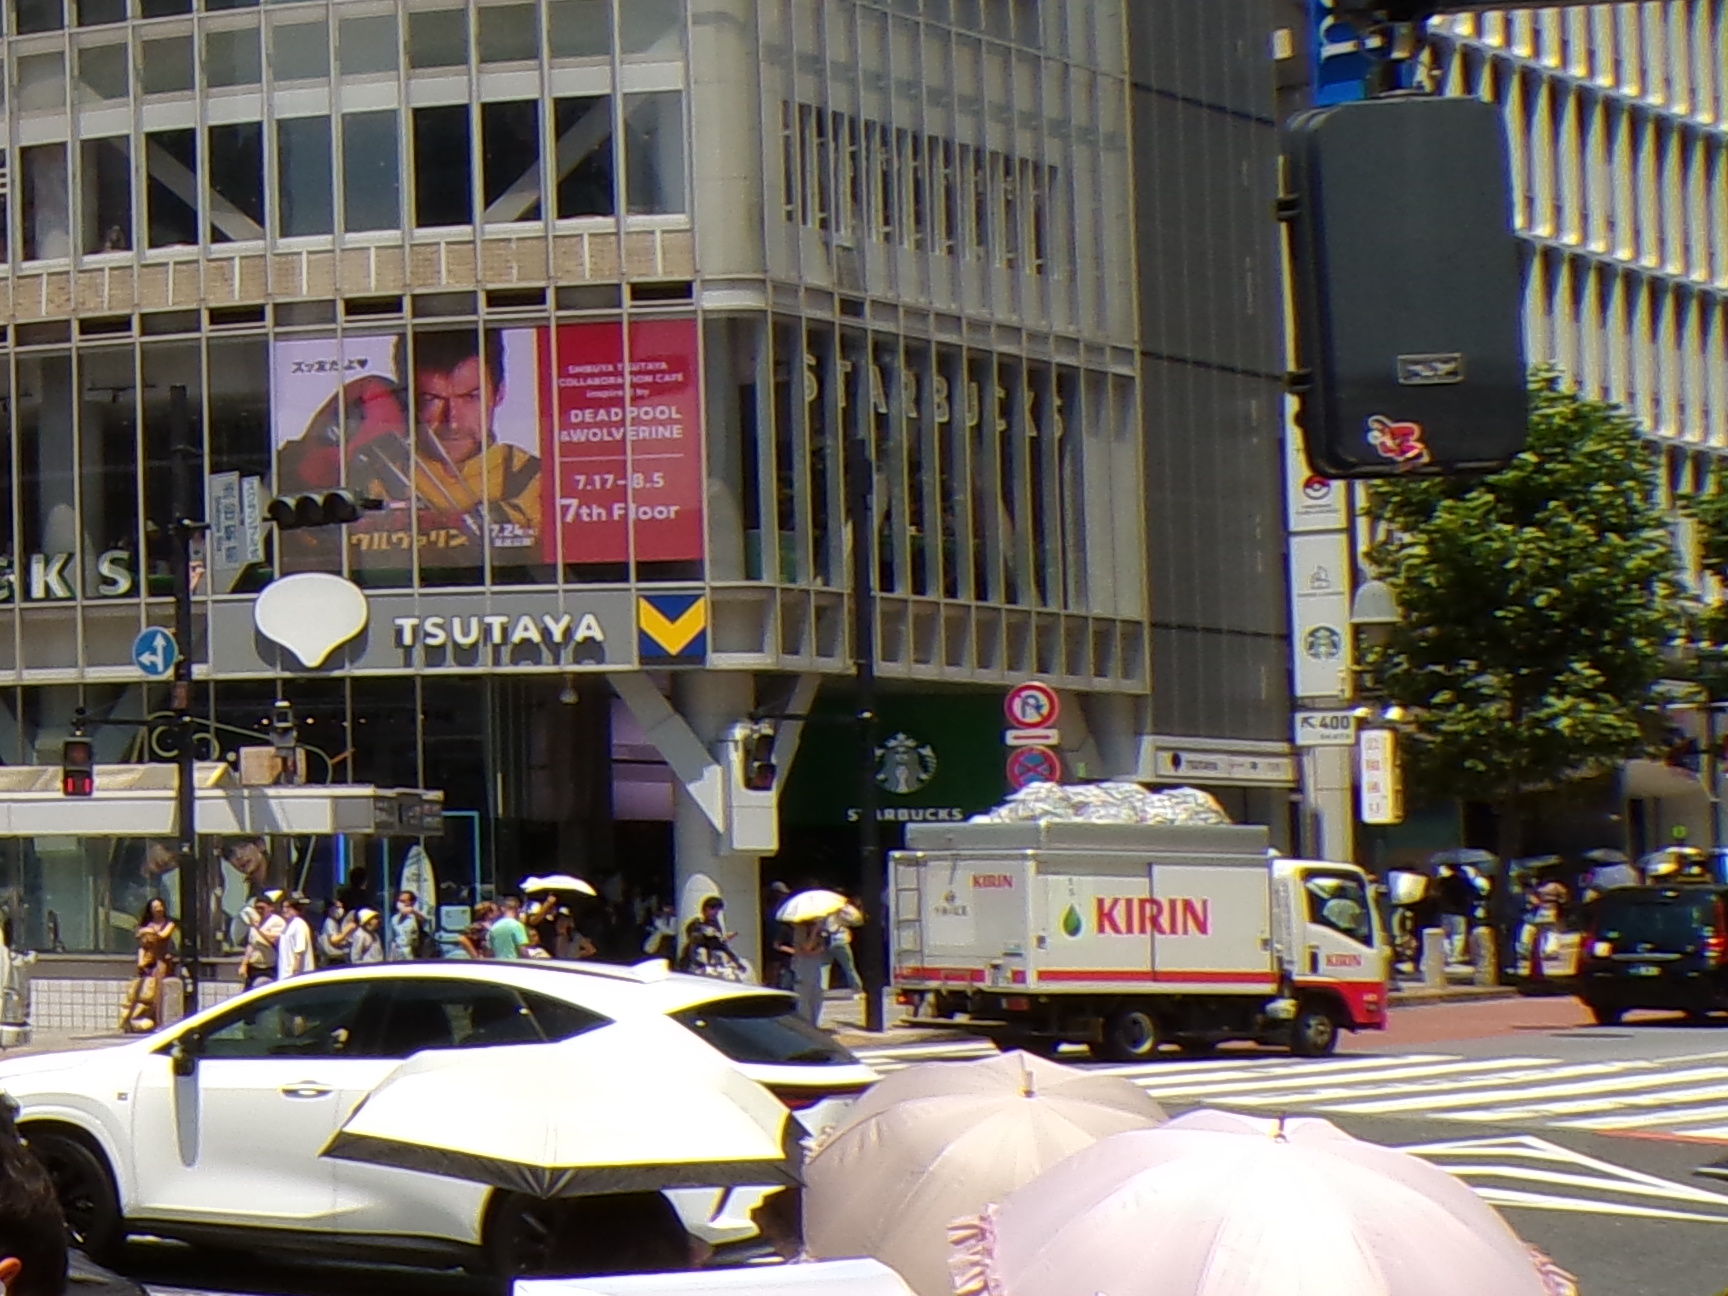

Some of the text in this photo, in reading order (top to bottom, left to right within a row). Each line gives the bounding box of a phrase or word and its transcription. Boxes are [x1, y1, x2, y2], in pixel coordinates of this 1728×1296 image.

[569, 405, 683, 423] DEADPOOL
[558, 497, 681, 523] 7th Floor
[394, 613, 605, 648] TSUTAYA
[847, 807, 964, 822] SARBUCKS
[971, 873, 1014, 890] KIRIN
[1095, 896, 1211, 936] KIRIN
